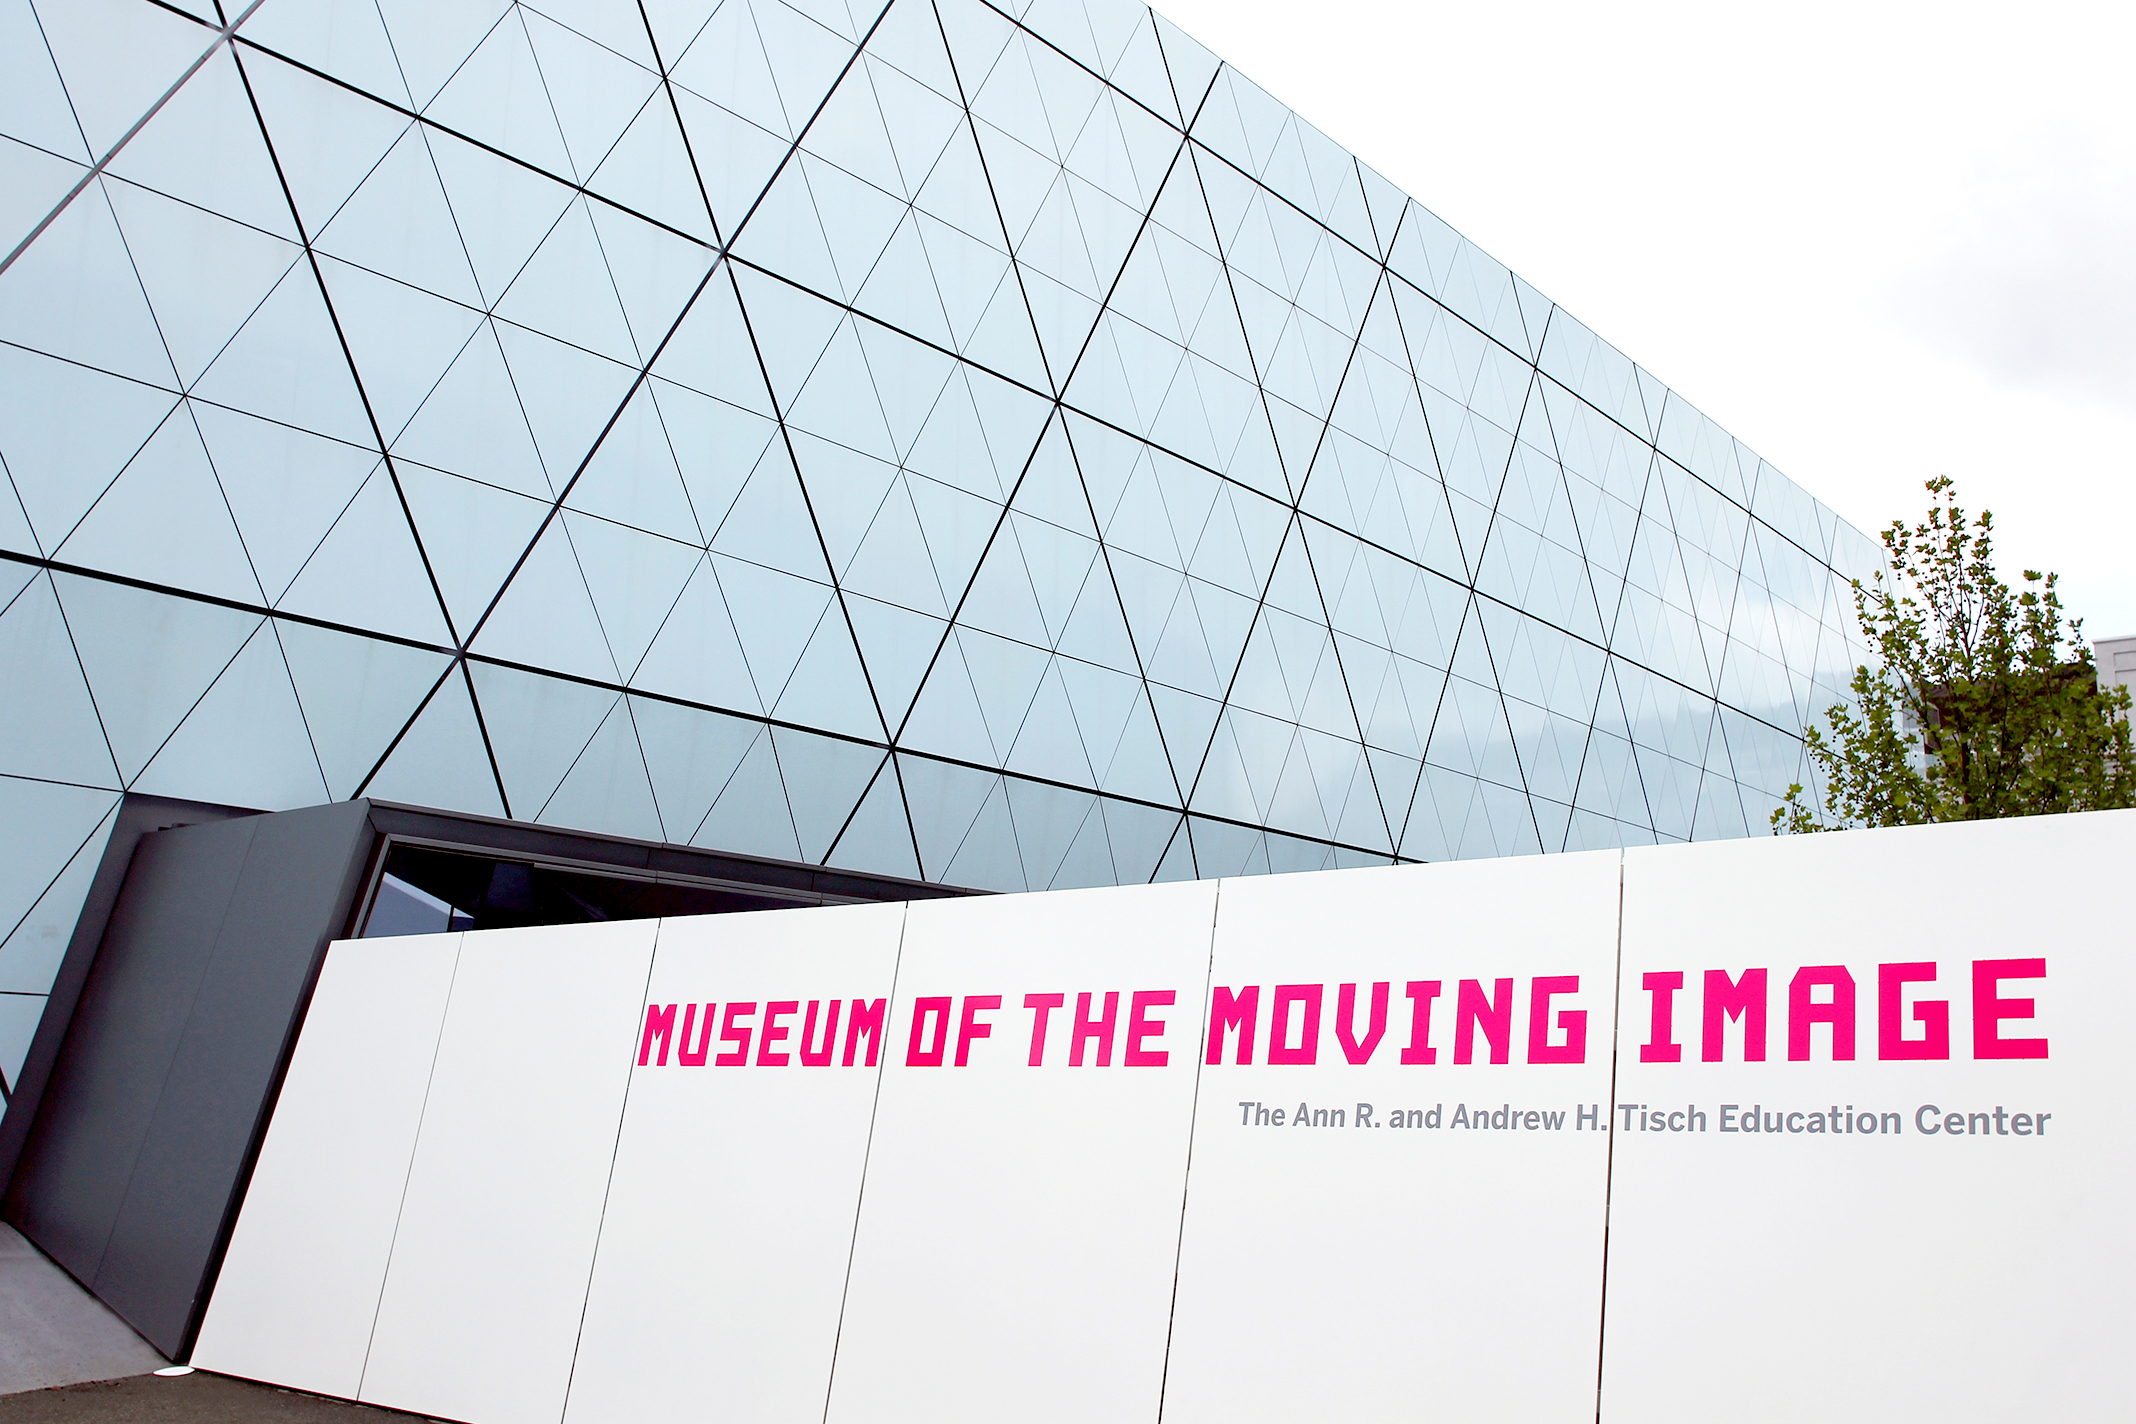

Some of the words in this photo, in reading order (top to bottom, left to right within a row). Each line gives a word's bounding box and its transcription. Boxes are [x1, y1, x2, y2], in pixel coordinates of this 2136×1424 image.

[638, 998, 885, 1066] MUSEUM
[906, 995, 1001, 1066] OF
[1024, 990, 1175, 1066] THE
[1206, 976, 1586, 1064] MOVING
[1640, 958, 2048, 1062] IMAGE
[1239, 1102, 1284, 1126] The
[1293, 1103, 1345, 1126] Ann
[1355, 1103, 1380, 1127] R.
[1389, 1104, 1442, 1128] and
[1450, 1104, 1566, 1129] Andrew
[1577, 1104, 1607, 1130] H.
[1618, 1104, 1706, 1131] Tisch
[1719, 1104, 1901, 1133] Education
[1915, 1105, 2051, 1134] Center
